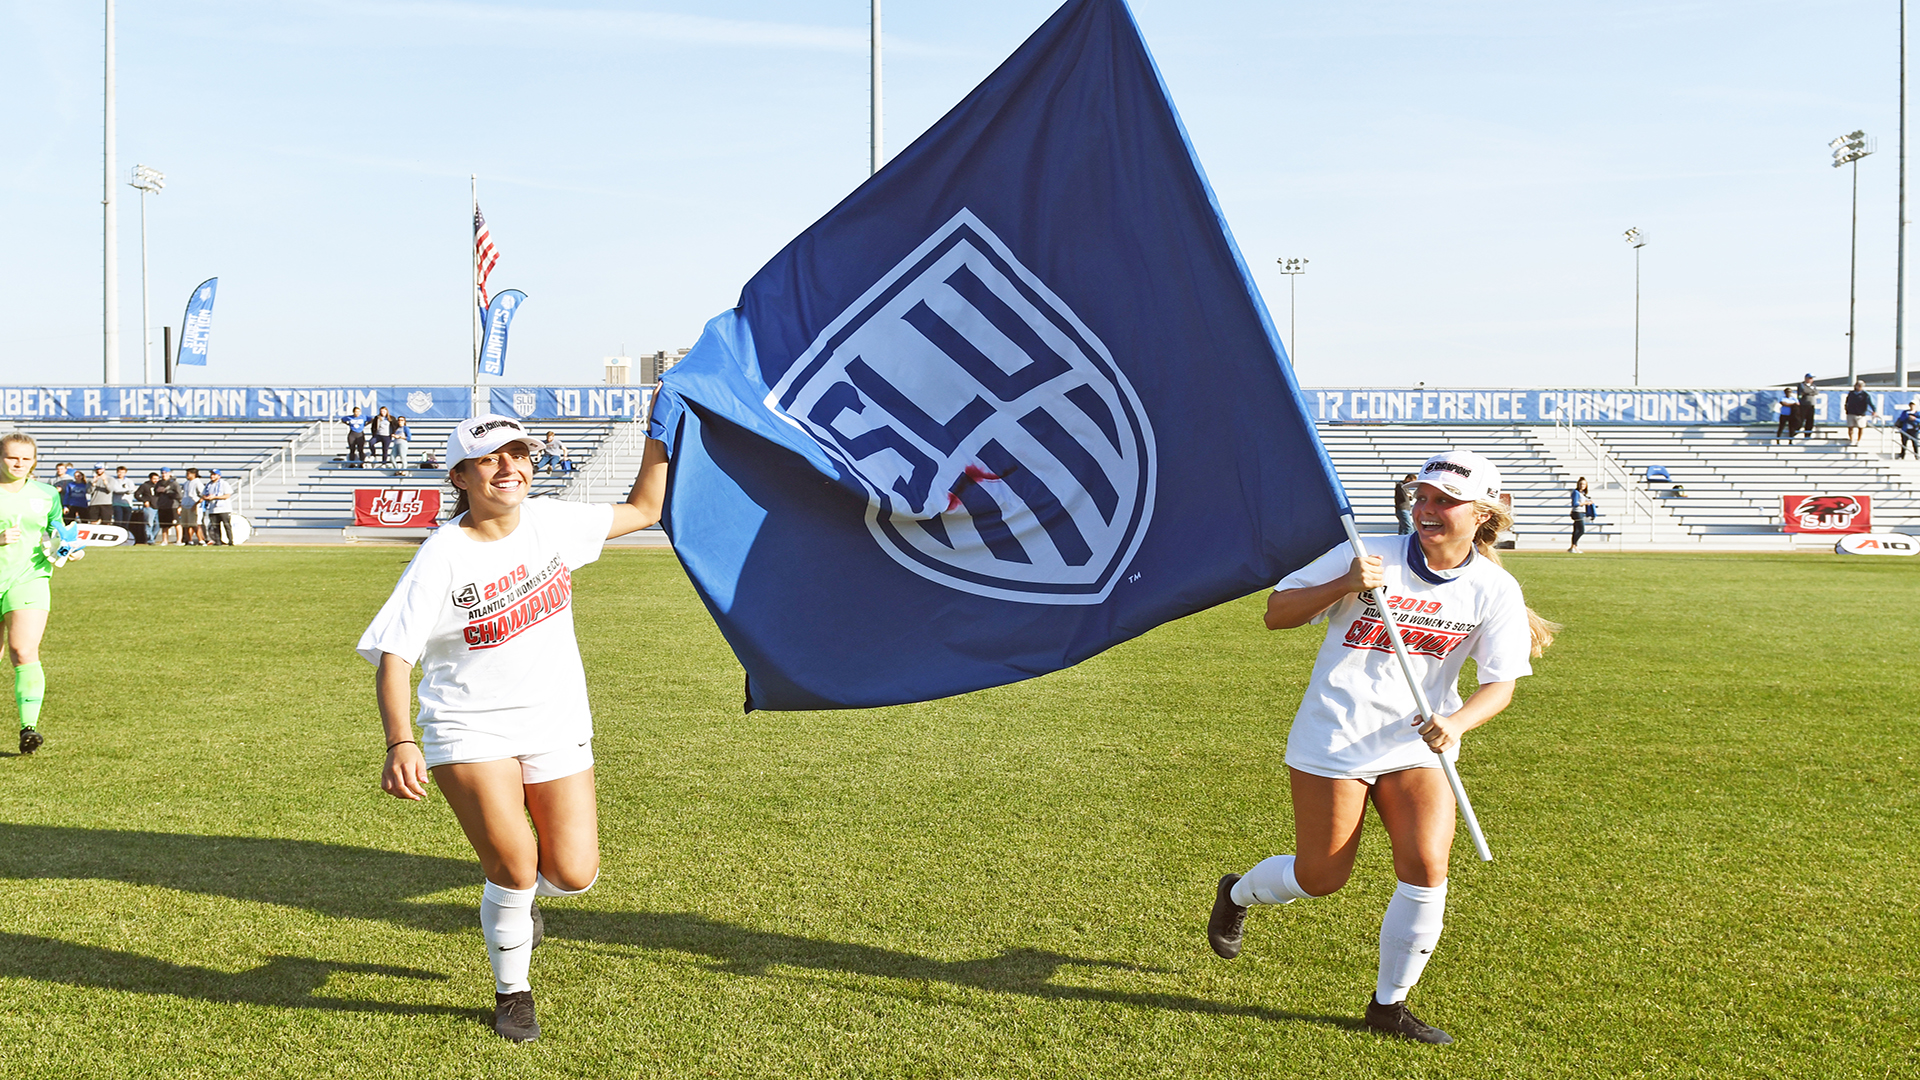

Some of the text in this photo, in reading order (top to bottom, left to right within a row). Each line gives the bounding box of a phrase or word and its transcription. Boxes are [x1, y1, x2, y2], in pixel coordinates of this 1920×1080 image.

[192, 309, 211, 355] SECTION
[484, 308, 510, 374] SLUNATICS
[516, 396, 533, 405] SLU
[807, 262, 1073, 514] SLU
[0, 389, 378, 417] BERT R. HERMANN STADIUM
[555, 389, 581, 417] 10
[1316, 392, 1344, 419] 17
[1351, 392, 1527, 420] CONFERENCE
[1539, 393, 1757, 421] CHAMPIONSHIPS
[1434, 461, 1472, 478] CHAMPIONS
[1804, 514, 1850, 527] SJU
[484, 564, 529, 601] 2019
[1128, 571, 1142, 584] TM
[463, 565, 572, 645] CHAMPIONS
[468, 598, 506, 620] ATLANTIC
[507, 592, 516, 604] 10
[515, 569, 547, 598] WOMEN'S
[1387, 595, 1443, 615] 2019
[1396, 613, 1407, 623] 10
[1408, 614, 1453, 631] WOMEN'S
[1344, 620, 1465, 655] CHAMPION
